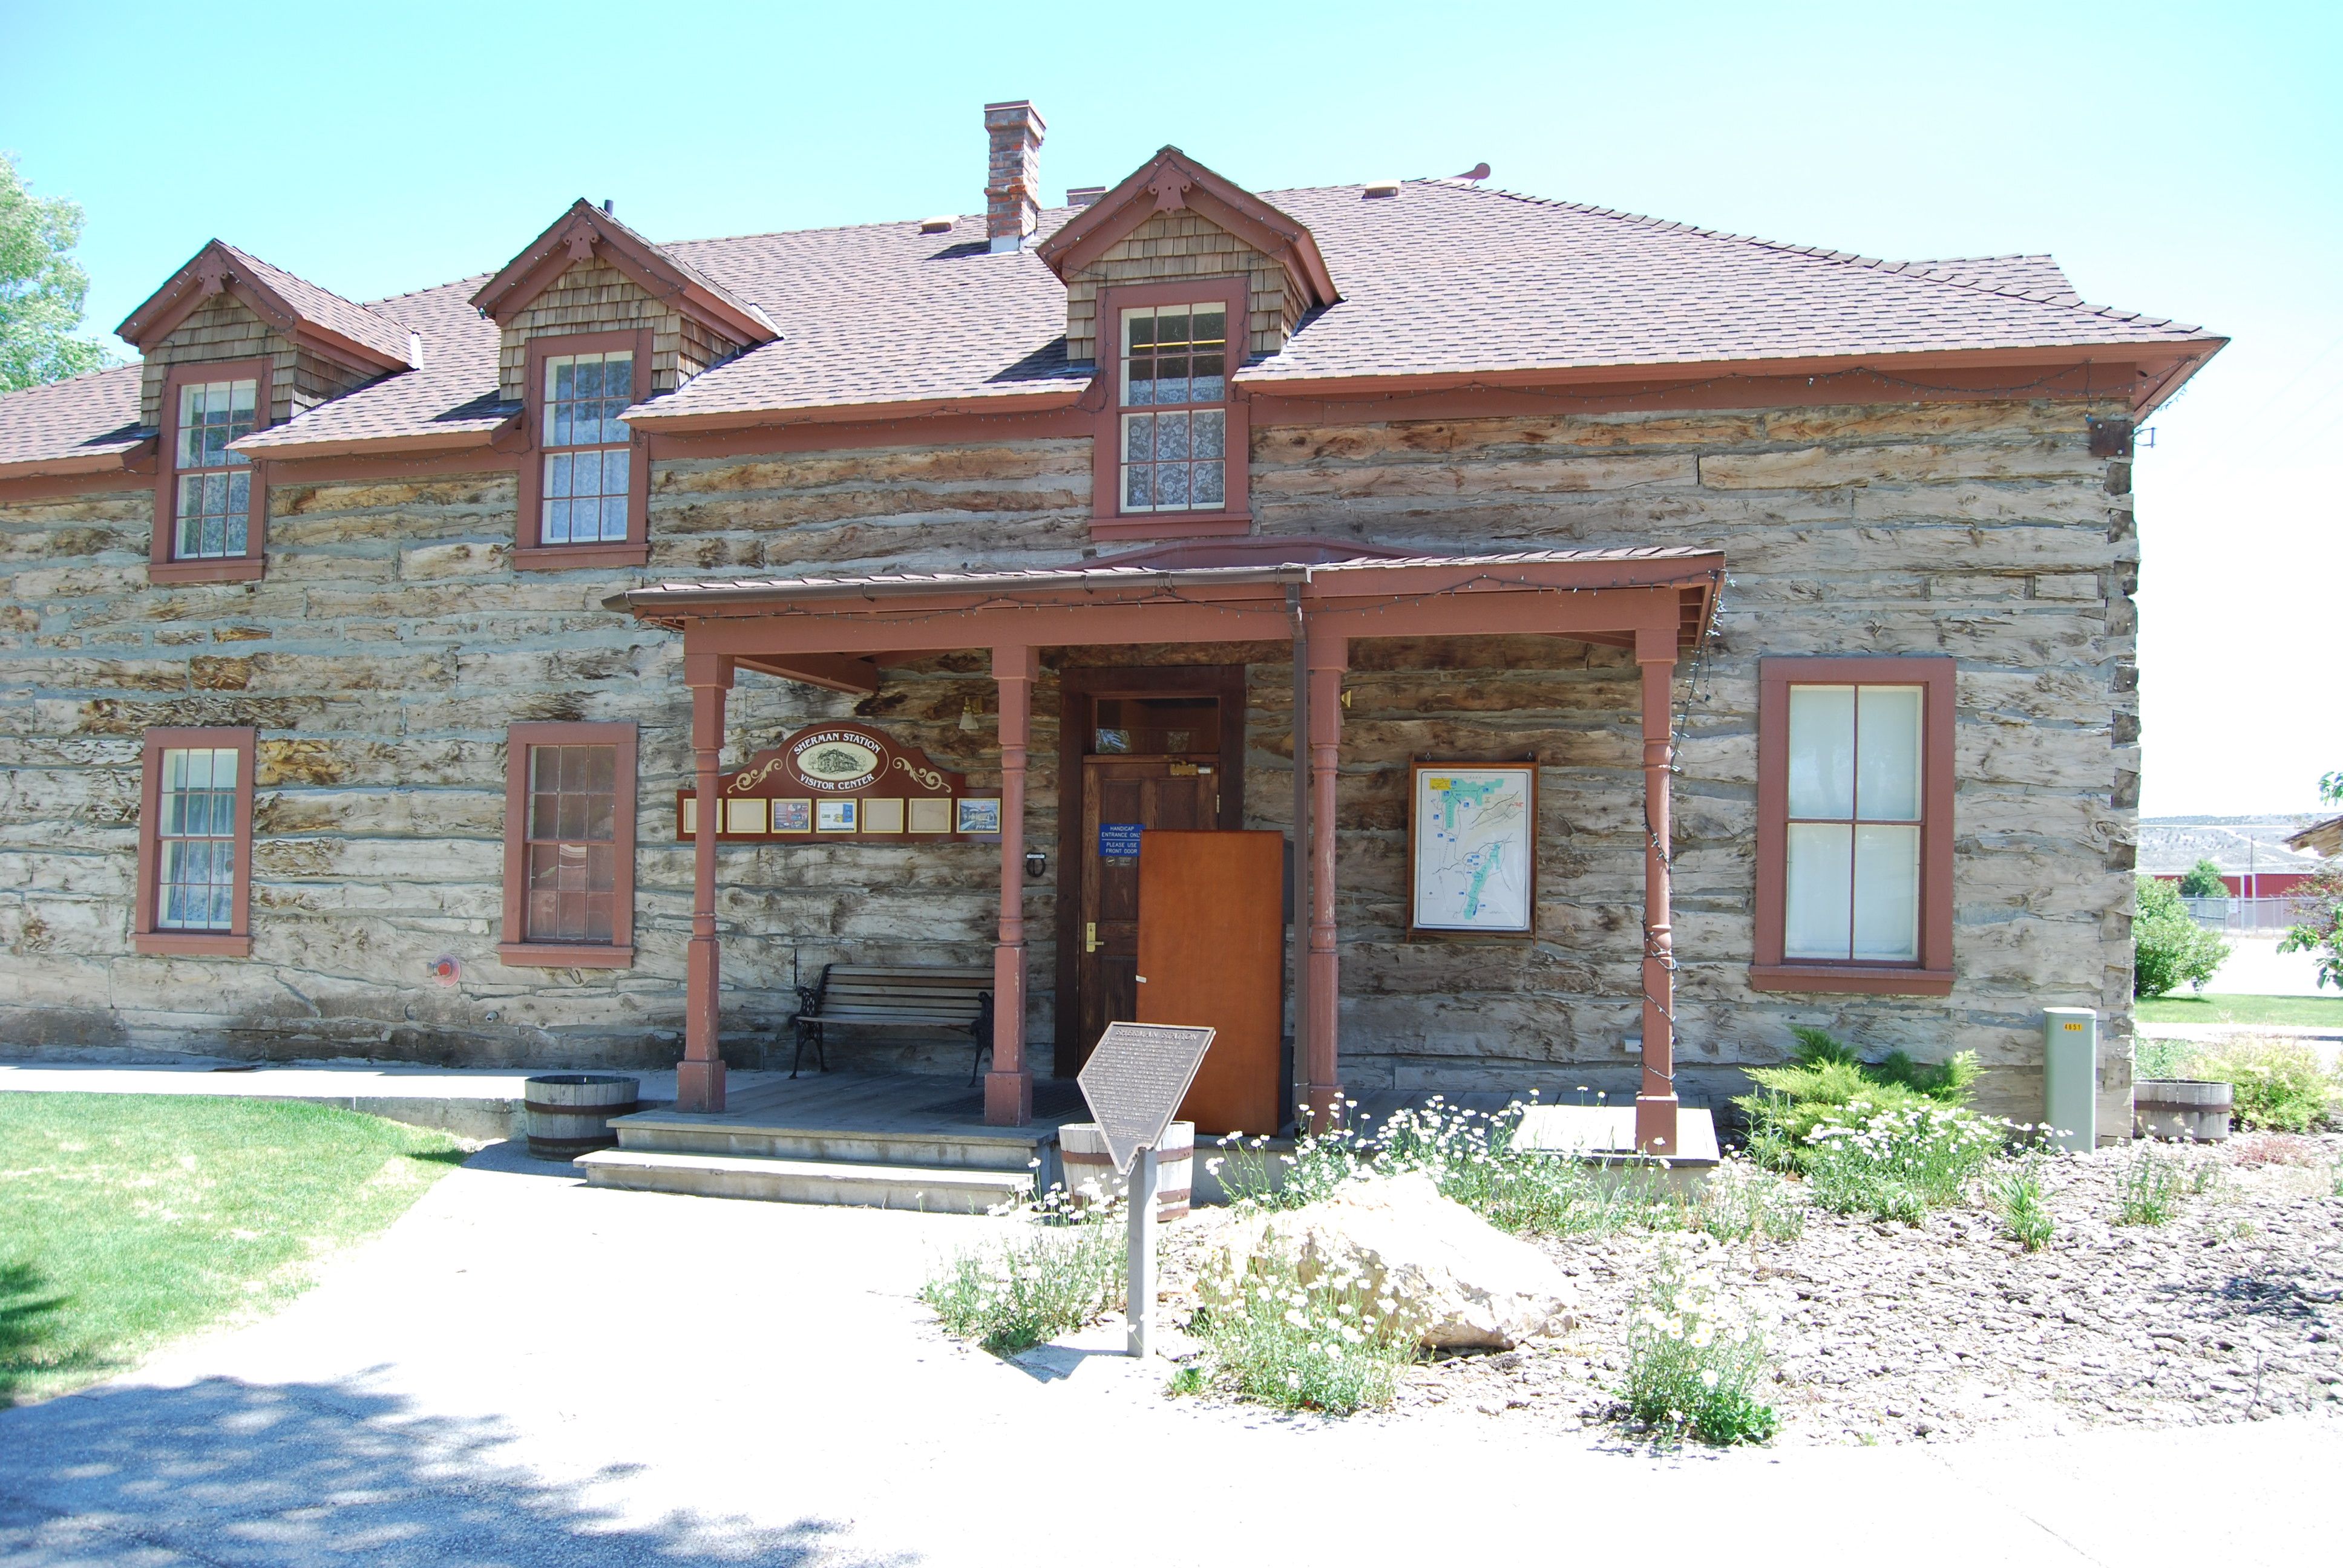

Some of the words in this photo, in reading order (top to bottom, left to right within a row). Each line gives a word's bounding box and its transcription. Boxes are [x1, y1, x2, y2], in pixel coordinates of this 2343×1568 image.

[794, 733, 839, 755] SHERMAN
[843, 733, 881, 754] STATION
[800, 773, 834, 790] VISITOR
[837, 773, 874, 790] CENTER
[1116, 1029, 1158, 1039] SHERMAN
[1161, 1031, 1199, 1041] STATION
